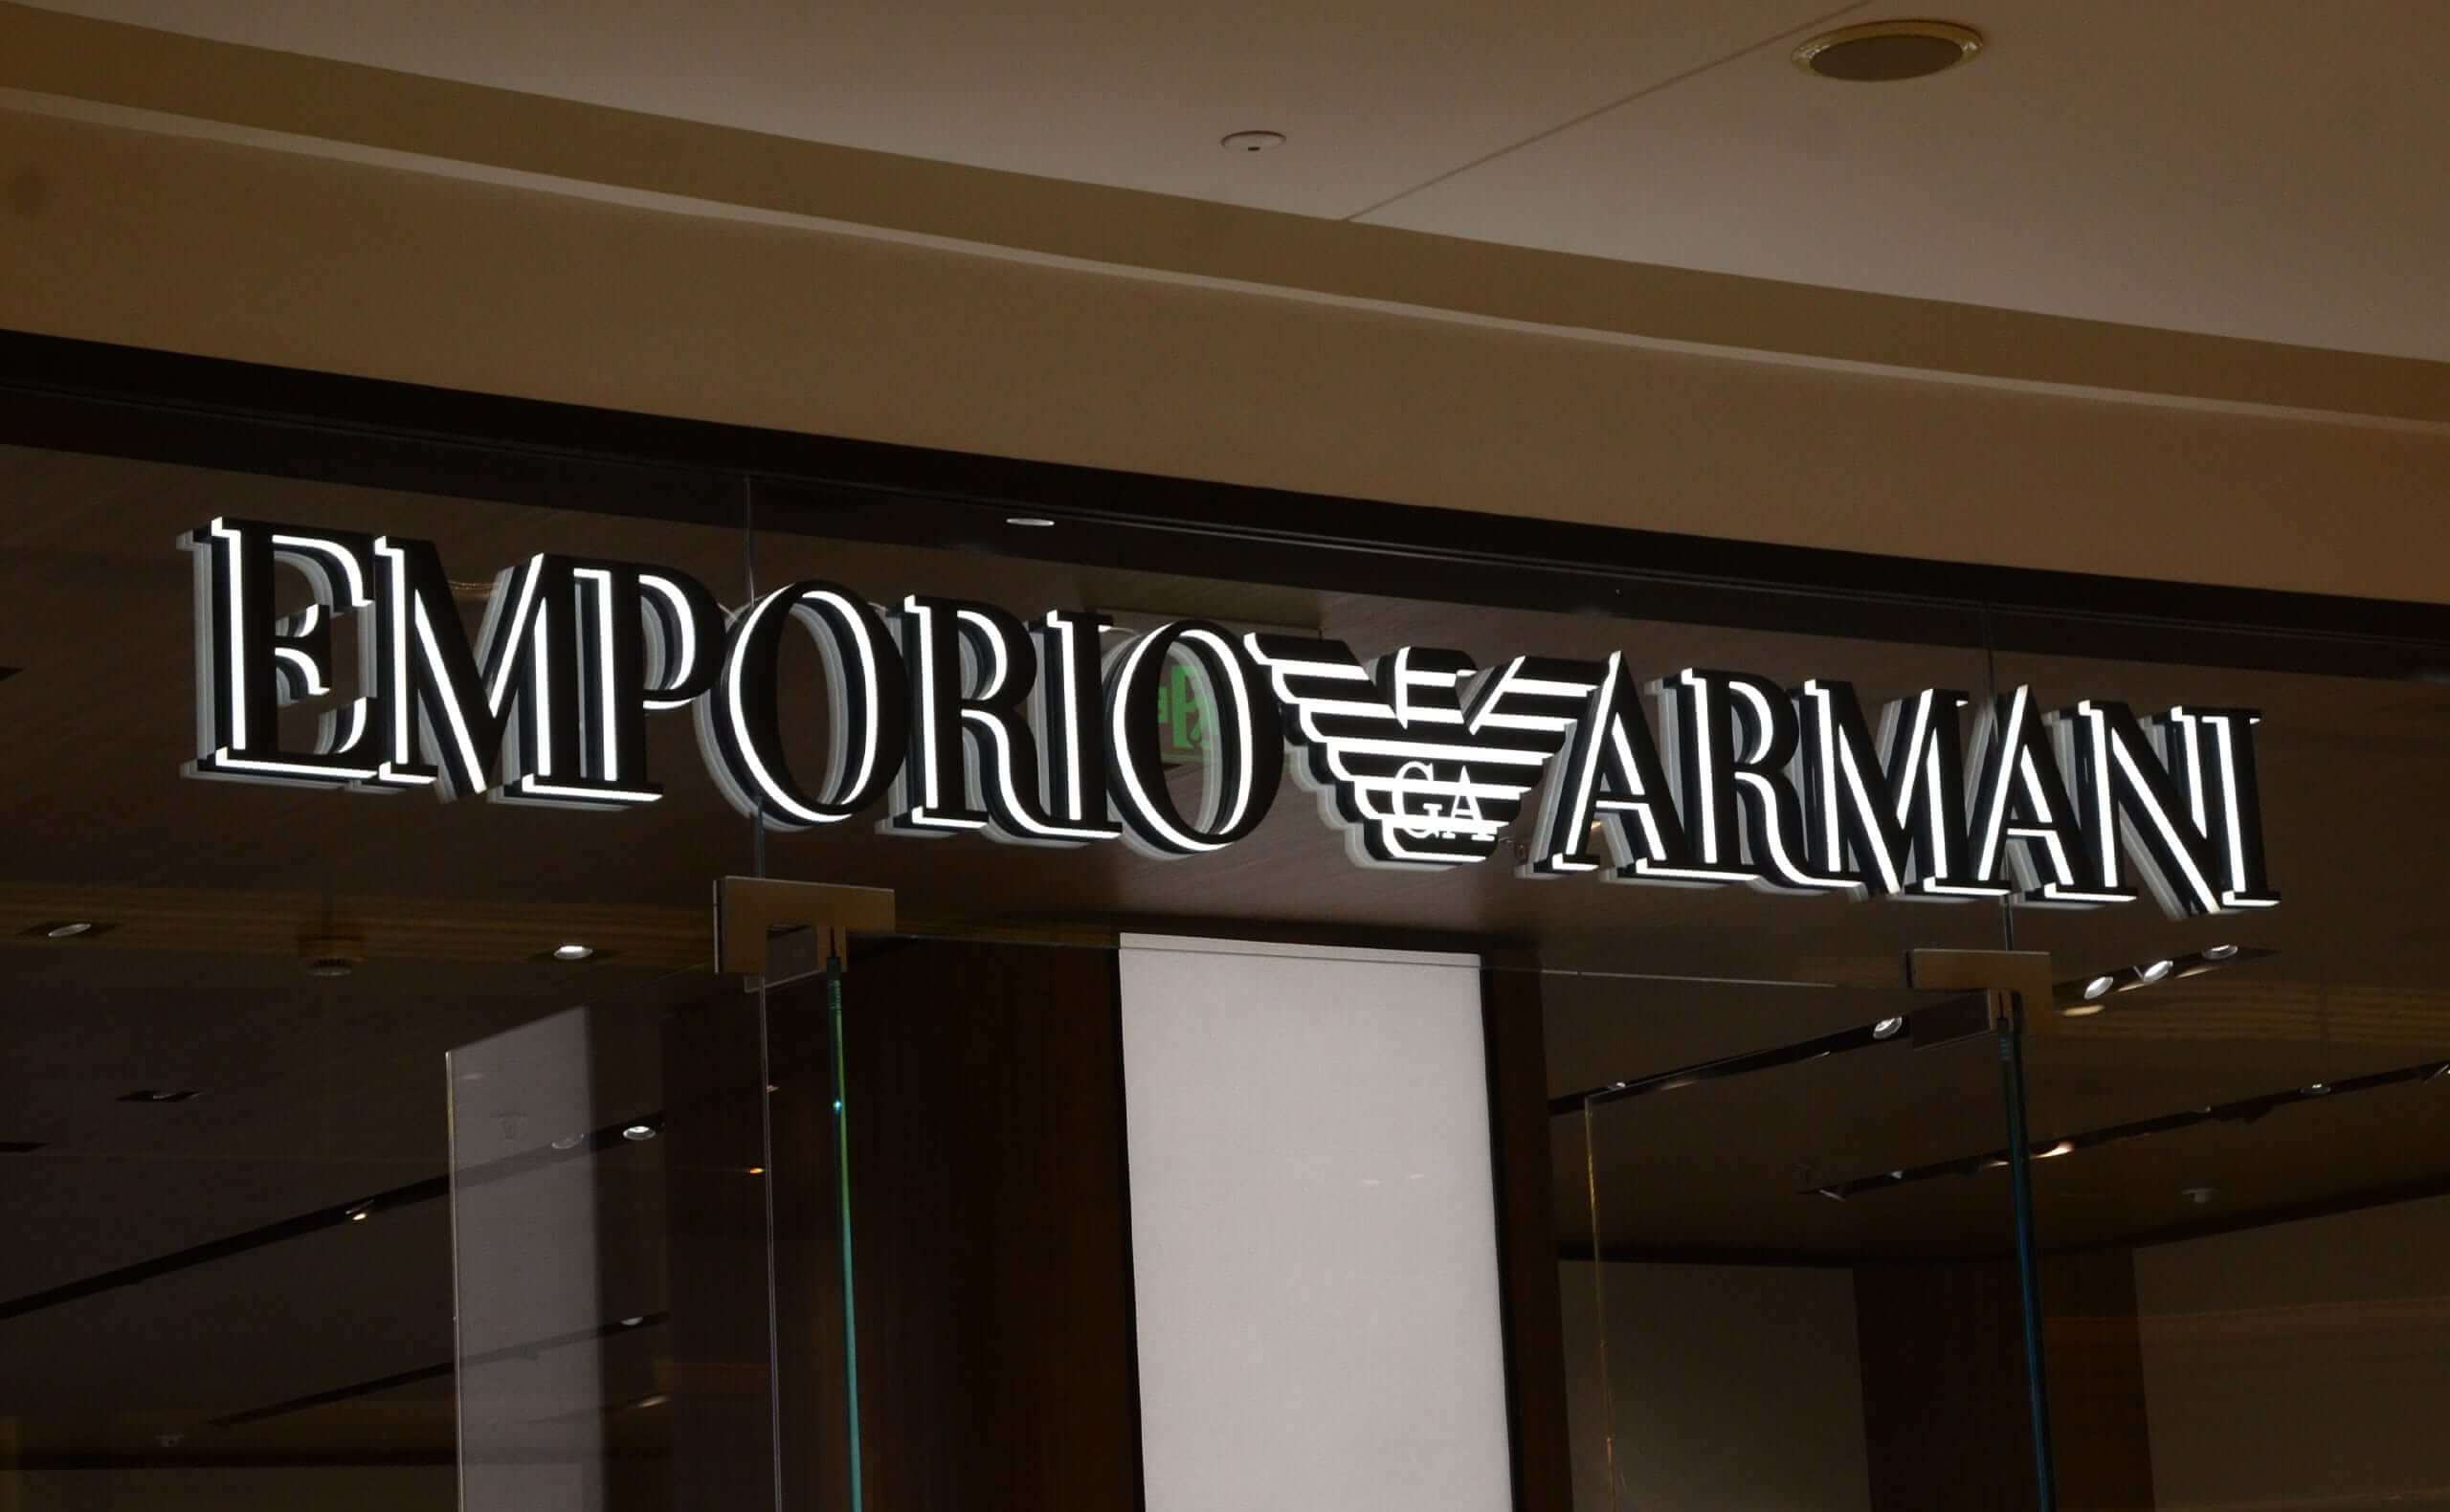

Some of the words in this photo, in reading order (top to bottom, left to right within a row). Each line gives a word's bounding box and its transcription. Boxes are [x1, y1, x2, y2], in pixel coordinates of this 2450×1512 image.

[205, 517, 1283, 852] EMPORIO
[1537, 651, 2282, 916] ARMANI
[1392, 761, 1496, 842] GA
